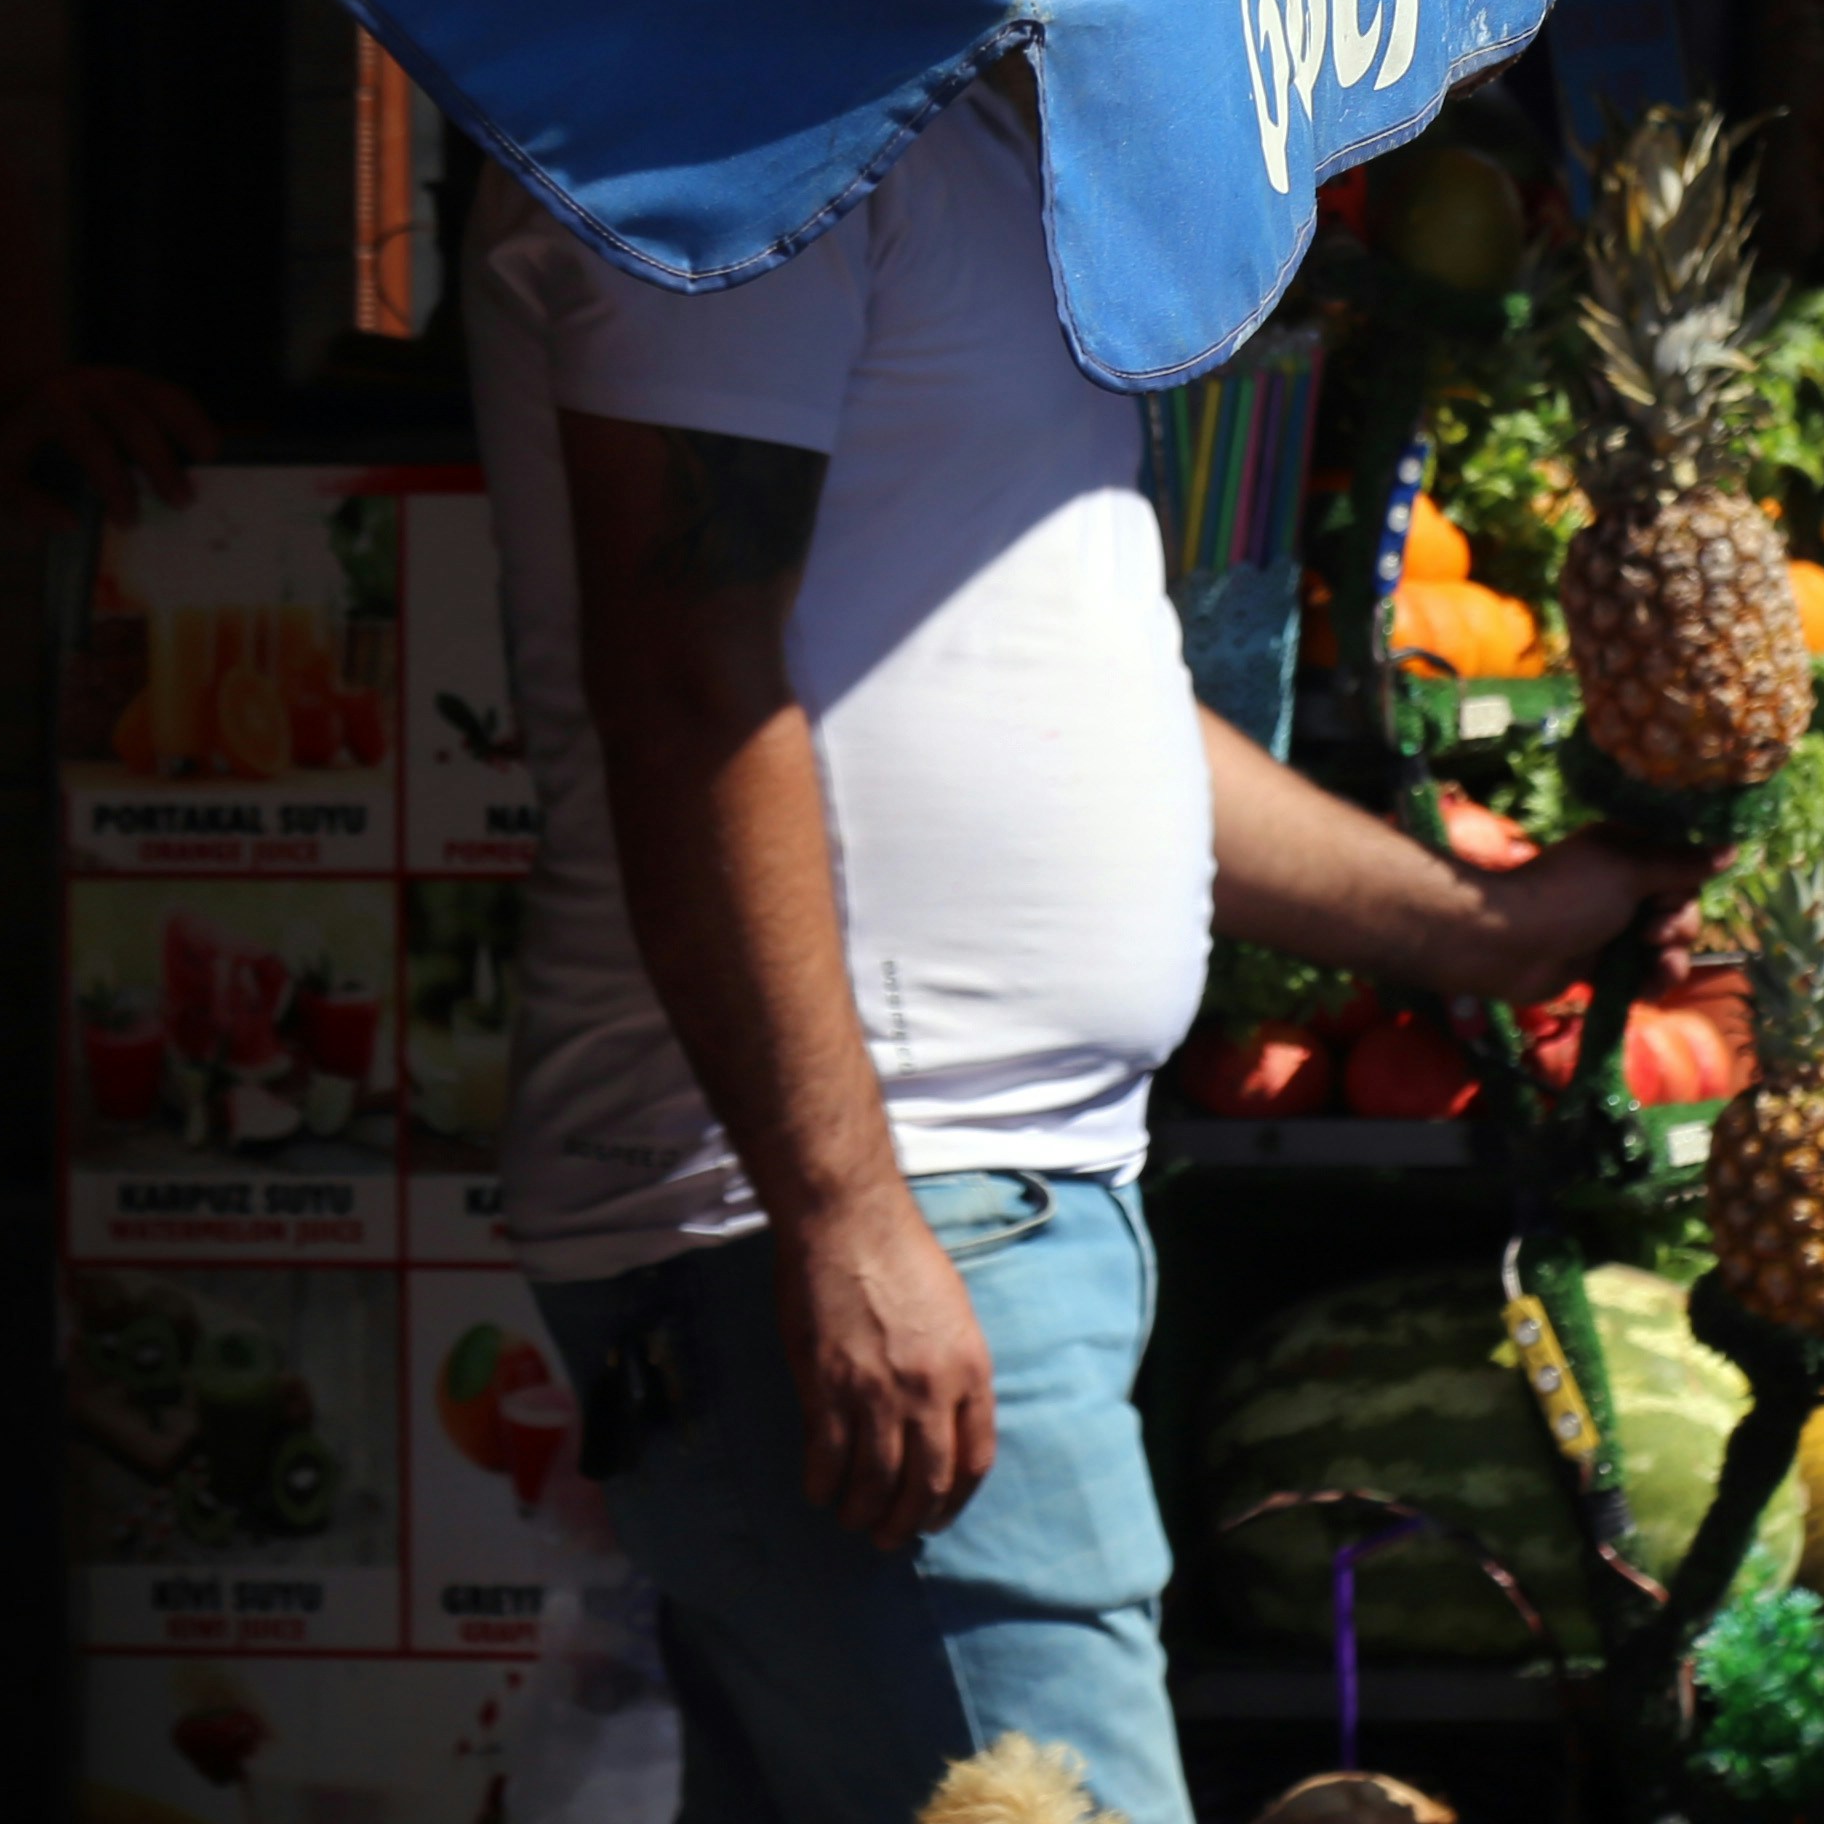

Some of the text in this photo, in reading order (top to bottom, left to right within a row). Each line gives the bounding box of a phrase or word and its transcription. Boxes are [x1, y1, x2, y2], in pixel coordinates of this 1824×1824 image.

[91, 804, 367, 834] PORTAKAL SUYU
[117, 1183, 354, 1214] KARPUZ SUYU
